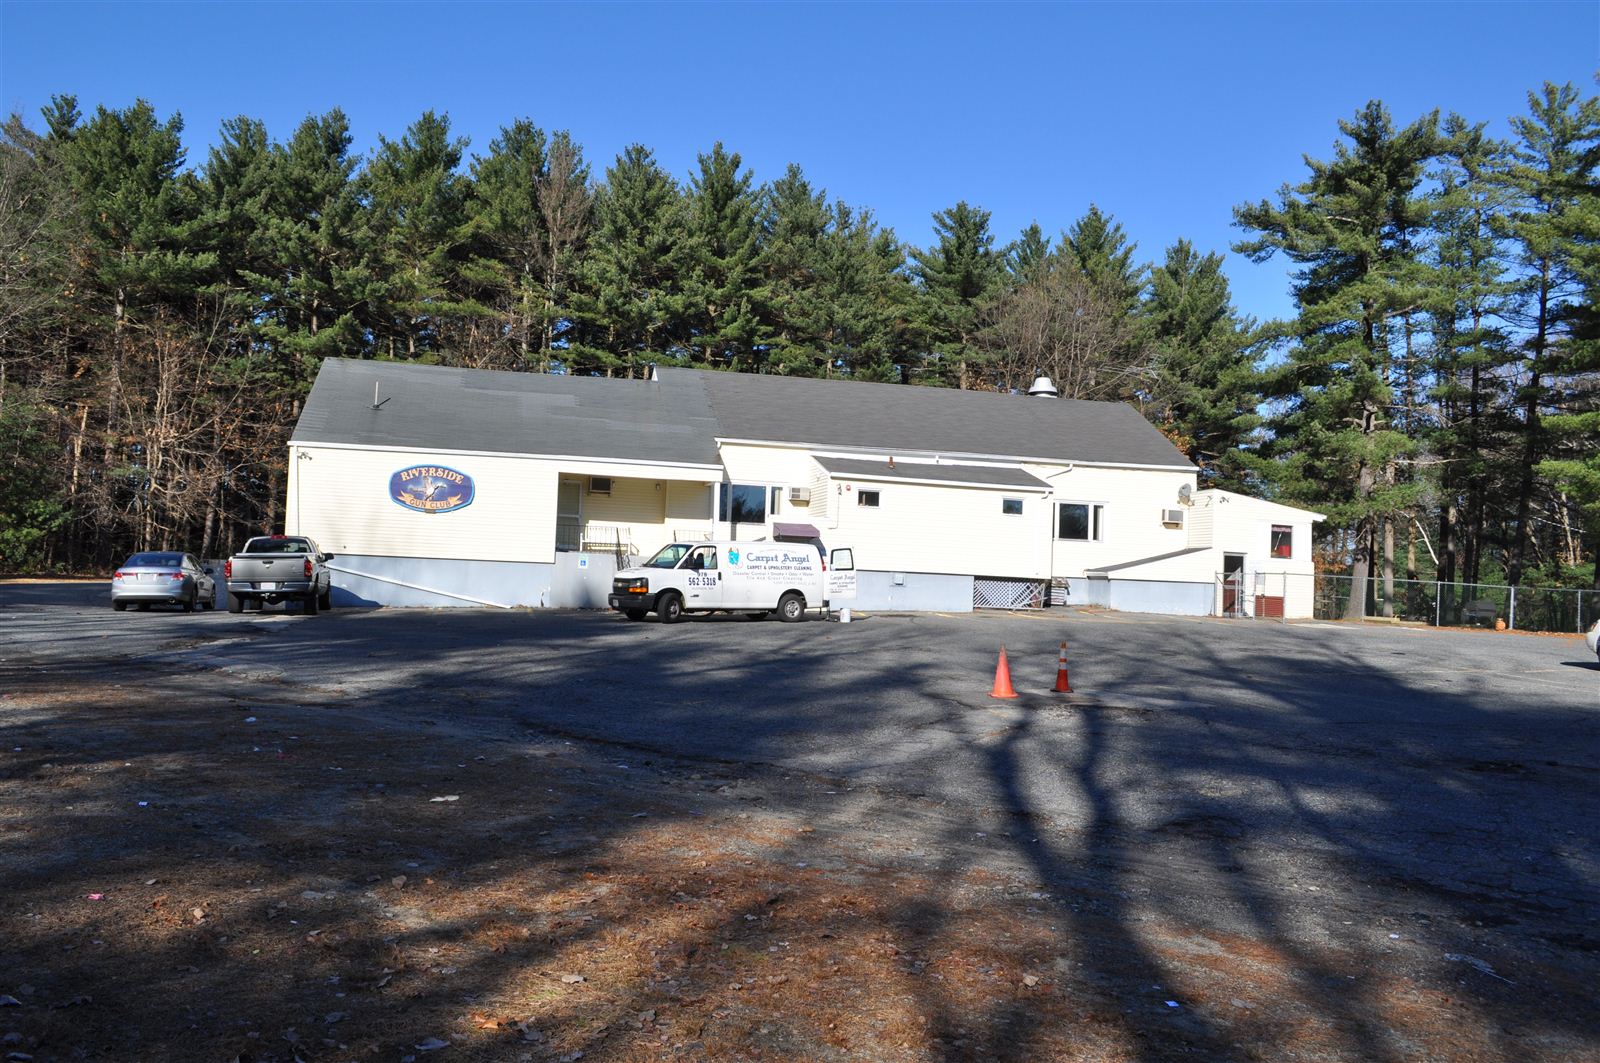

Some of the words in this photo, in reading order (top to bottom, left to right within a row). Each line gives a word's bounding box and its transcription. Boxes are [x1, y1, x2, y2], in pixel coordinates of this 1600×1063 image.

[400, 466, 464, 484] RIVERSIDE
[409, 498, 426, 508] GUN
[781, 553, 810, 564] Angel
